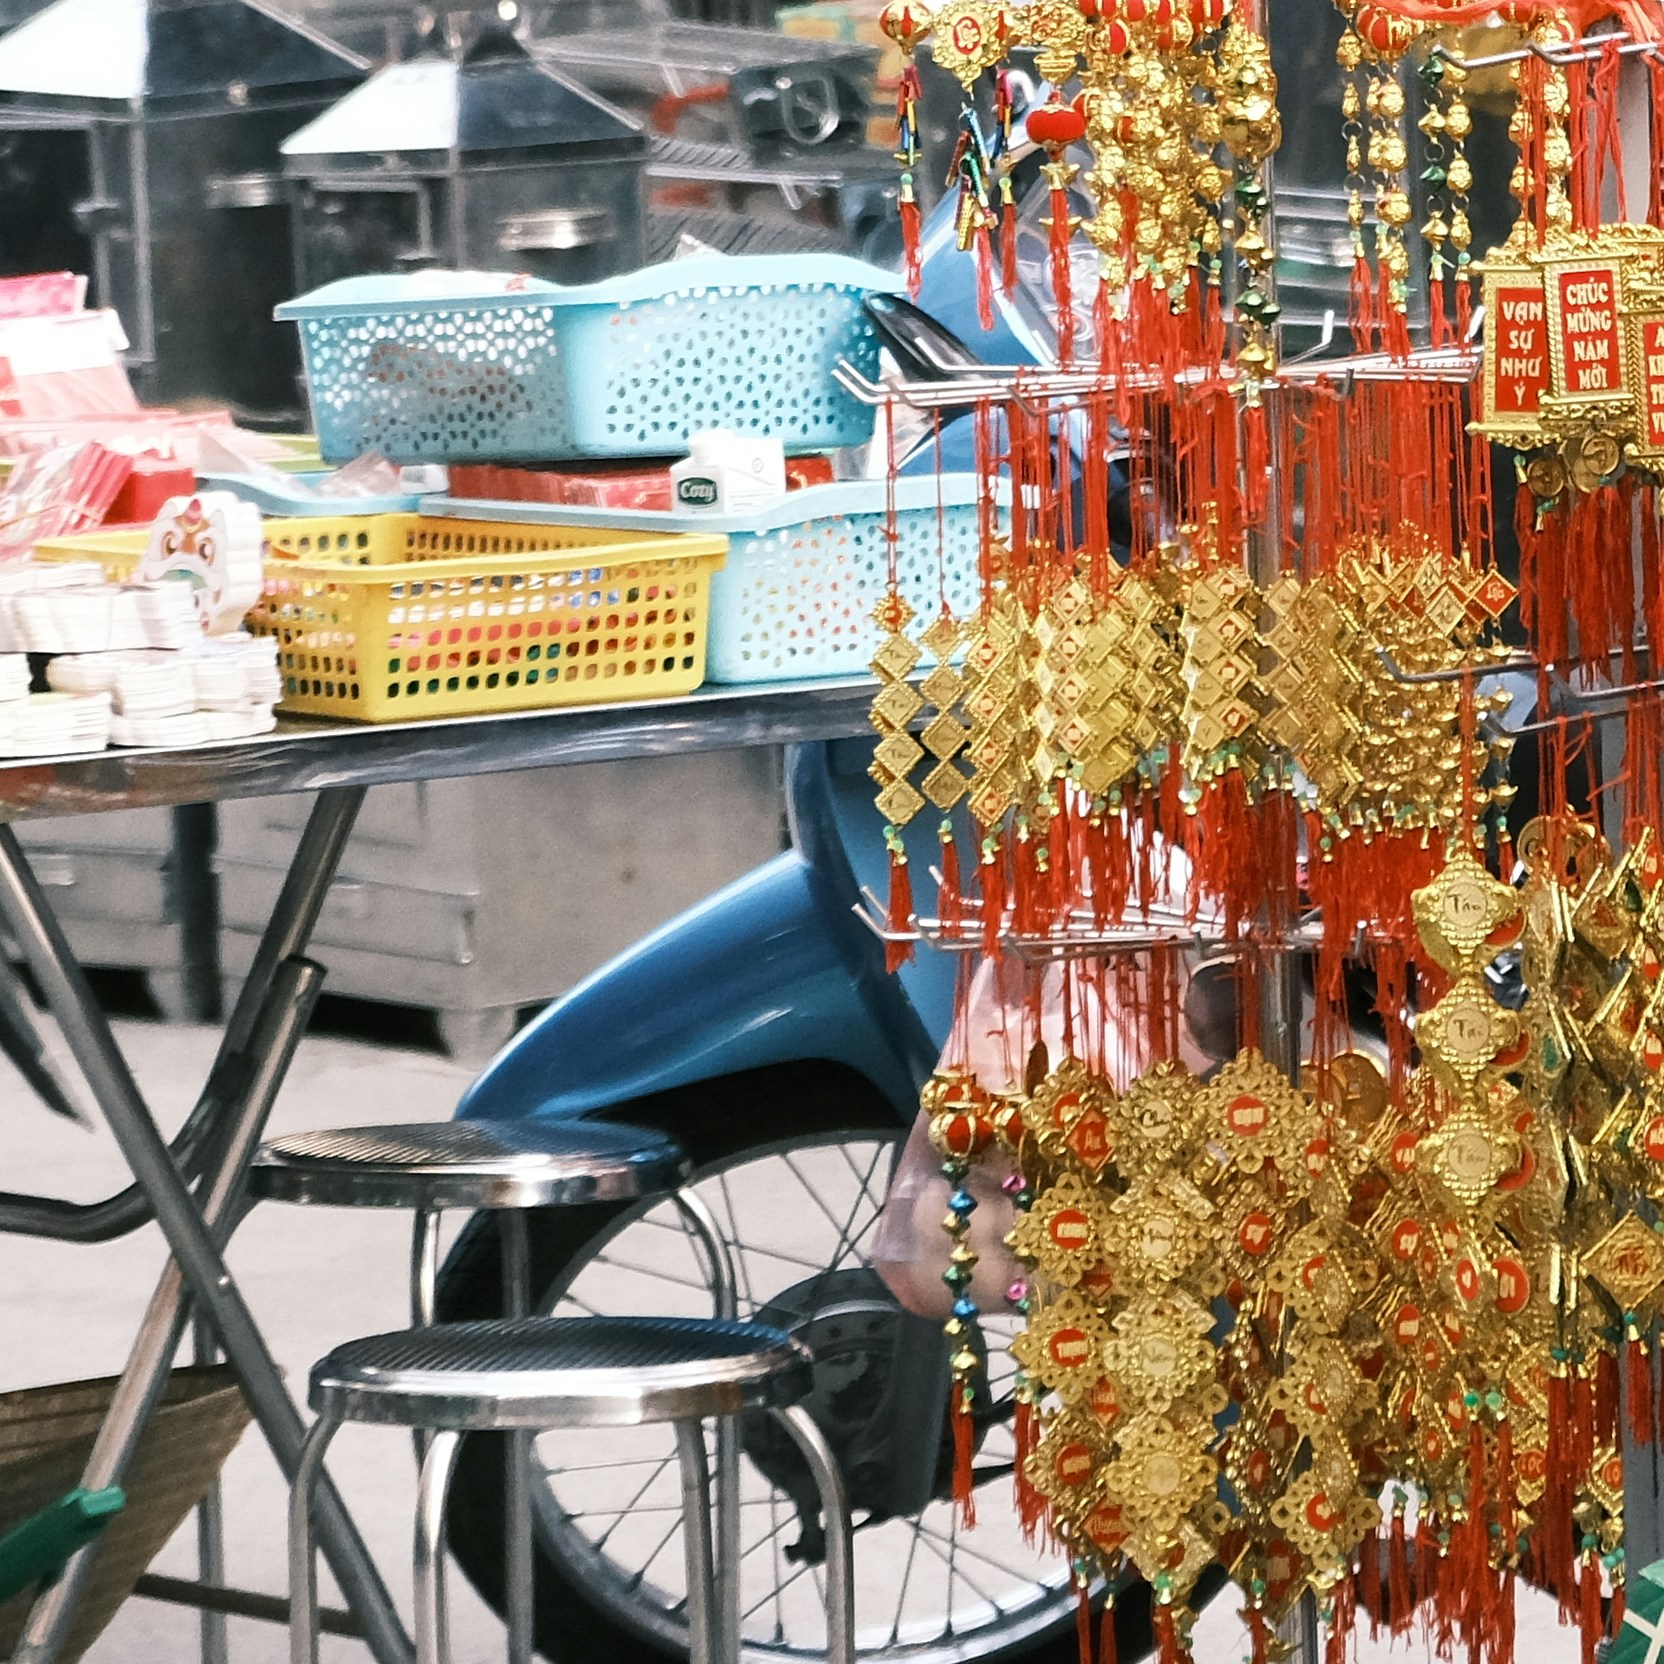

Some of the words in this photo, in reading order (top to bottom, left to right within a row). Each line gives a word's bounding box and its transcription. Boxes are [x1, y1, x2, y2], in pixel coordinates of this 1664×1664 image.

[1566, 278, 1609, 306] CHÚC
[1502, 301, 1543, 326] VẠN
[1566, 306, 1612, 334] MỪNG
[1508, 328, 1535, 354] SỰ
[1572, 338, 1610, 362] NĂM
[1500, 356, 1543, 378] NHƯ
[1578, 362, 1609, 391] MỚI
[1513, 381, 1527, 406] Ý
[681, 481, 715, 502] Cozy
